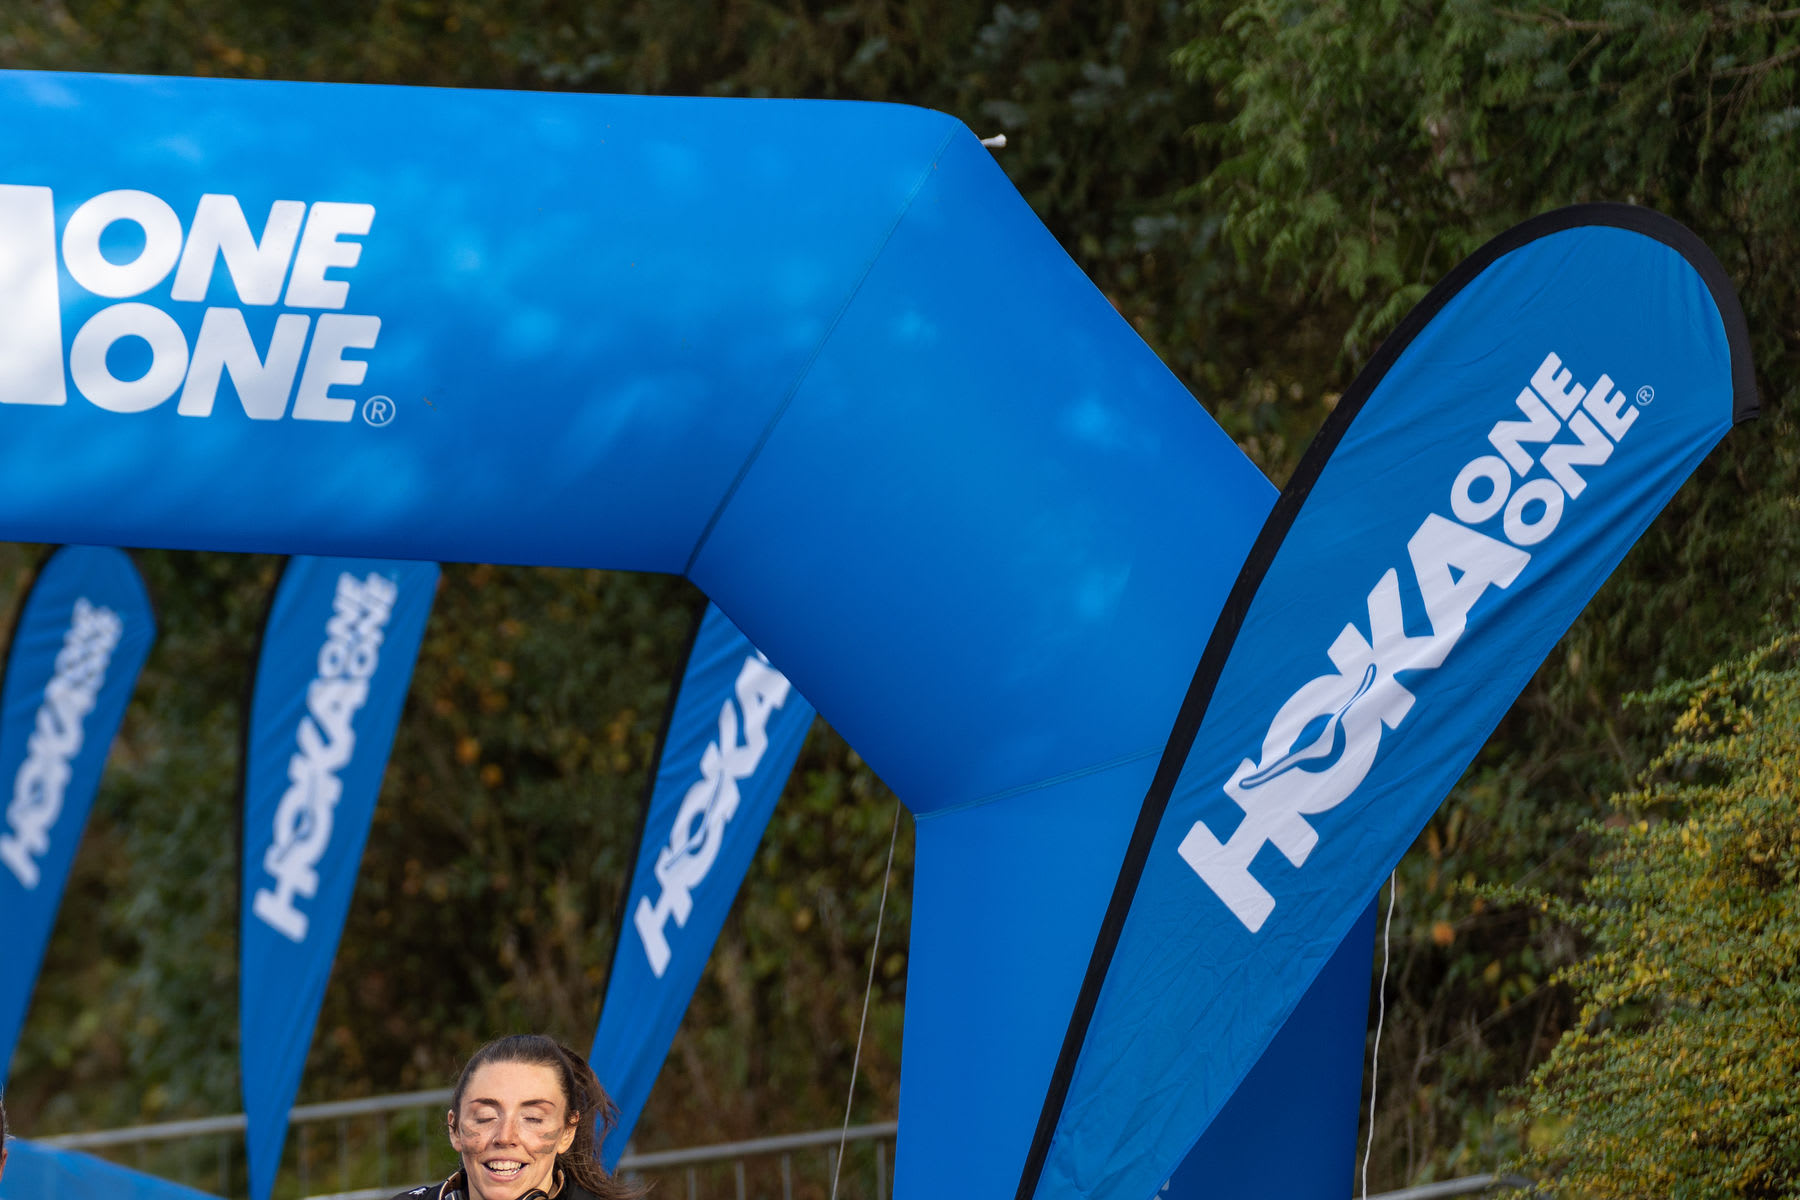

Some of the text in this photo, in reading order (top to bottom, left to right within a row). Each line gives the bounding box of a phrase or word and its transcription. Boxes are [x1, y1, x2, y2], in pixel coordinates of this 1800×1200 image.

[61, 188, 376, 309] ONE
[70, 300, 383, 422] ONE
[1503, 373, 1640, 546] ONE
[1177, 351, 1587, 934] HOKA ONE
[252, 677, 371, 943] HOKA
[634, 655, 792, 979] HOKA
